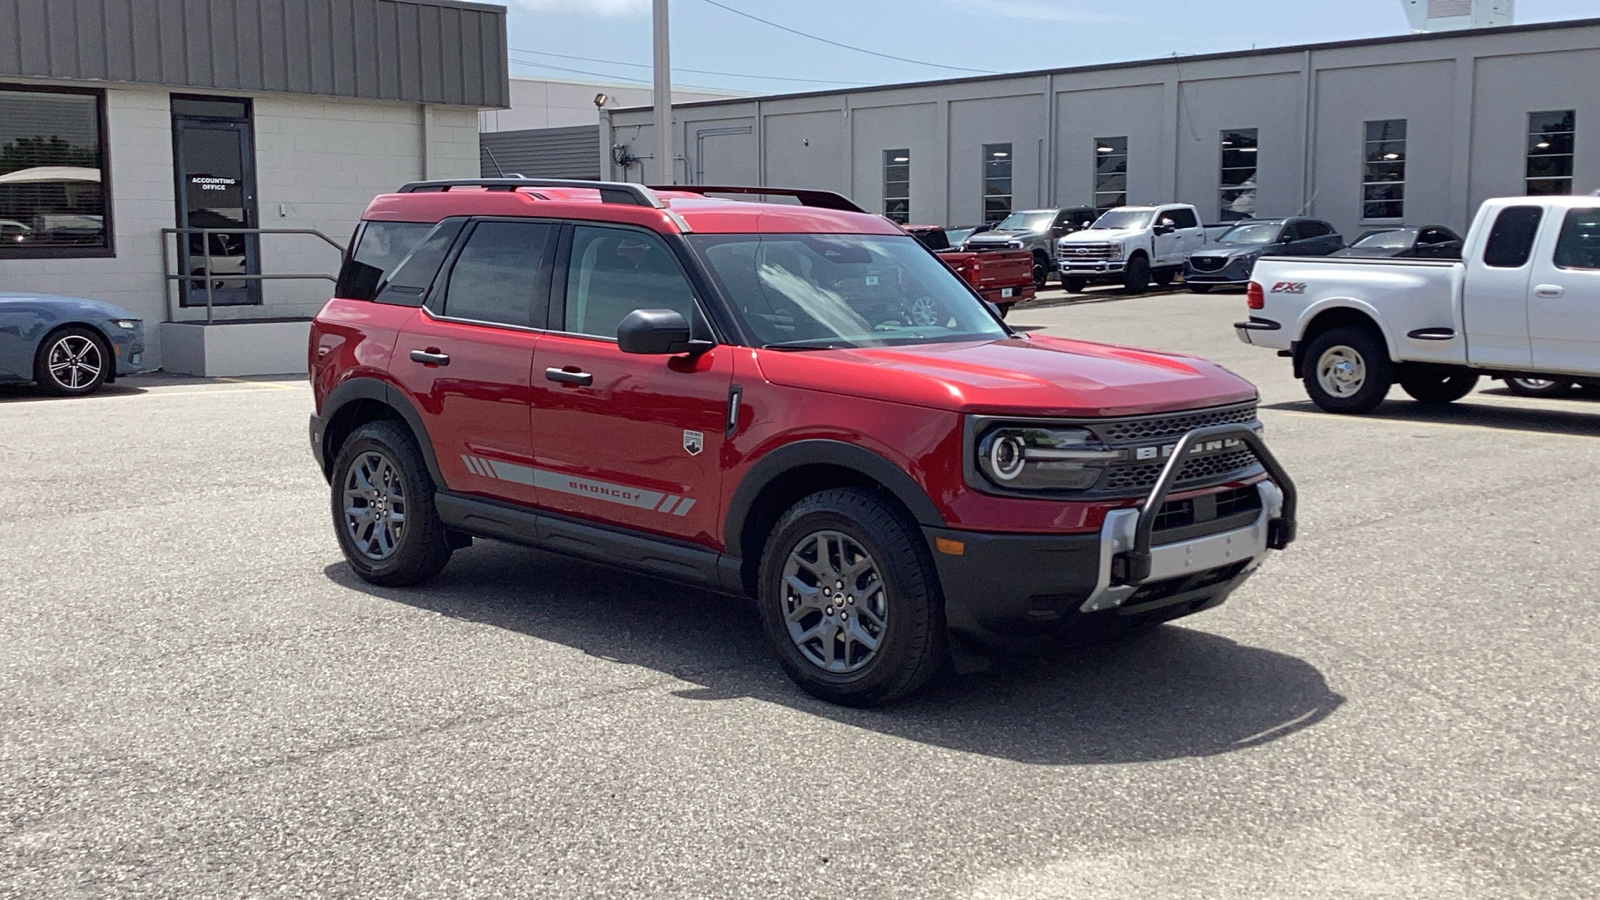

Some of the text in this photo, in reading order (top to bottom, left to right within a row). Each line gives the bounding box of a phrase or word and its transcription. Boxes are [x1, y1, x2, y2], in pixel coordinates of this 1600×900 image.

[1271, 281, 1307, 292] FX4
[1136, 438, 1245, 460] BRNC
[569, 481, 631, 499] BRONCO
